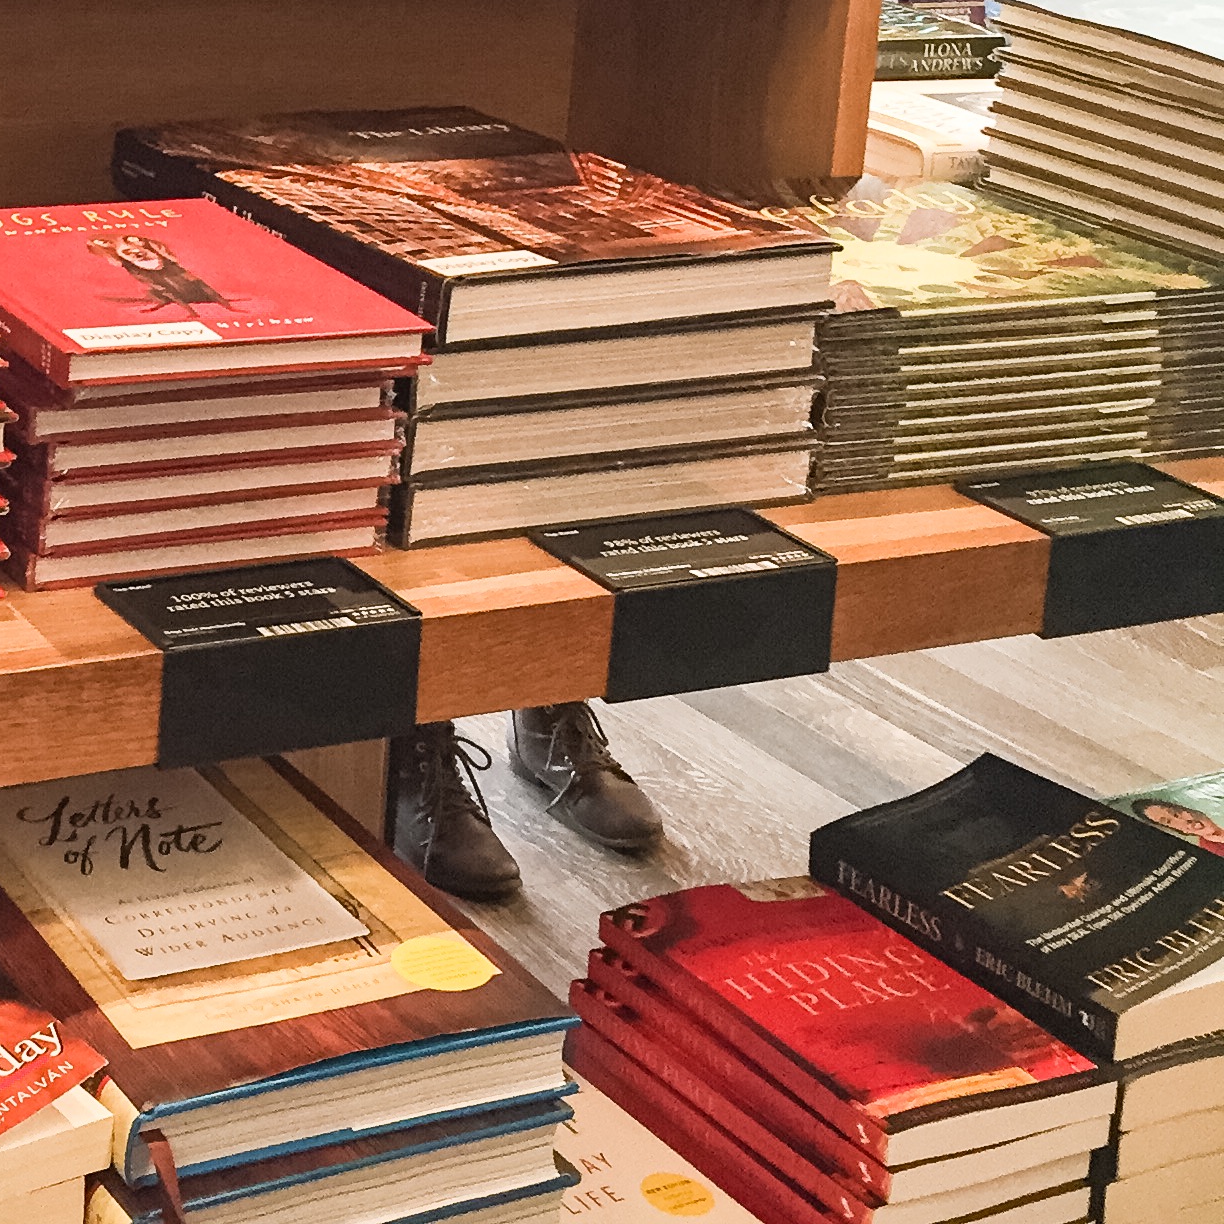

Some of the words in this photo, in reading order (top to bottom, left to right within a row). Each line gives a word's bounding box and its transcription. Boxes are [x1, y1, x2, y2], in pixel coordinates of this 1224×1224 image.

[909, 57, 983, 72] ANDREWS
[924, 43, 972, 58] ILONA
[408, 124, 511, 136] Library
[83, 209, 182, 222] RULE
[81, 329, 153, 345] Display
[157, 326, 204, 342] Copy
[167, 601, 210, 613] rated
[212, 597, 244, 608] this
[246, 592, 282, 604] book
[299, 586, 336, 597] stars
[171, 591, 218, 603] 100%
[220, 588, 235, 598] of
[238, 580, 314, 595] reviewers
[16, 794, 175, 846] Letters
[64, 835, 98, 875] of
[106, 822, 223, 873] Note
[938, 812, 1119, 910] FEARLESS
[104, 886, 293, 925] CORRESPONDENCE
[838, 860, 942, 941] FEARLESS
[135, 940, 207, 957] WIDER
[222, 916, 327, 943] AUDIENCE
[138, 913, 258, 938] DESERVING
[725, 946, 924, 1000] HIDING
[976, 947, 1015, 982] ERIC
[789, 971, 950, 1016] PLACE
[562, 1186, 624, 1214] LIFE
